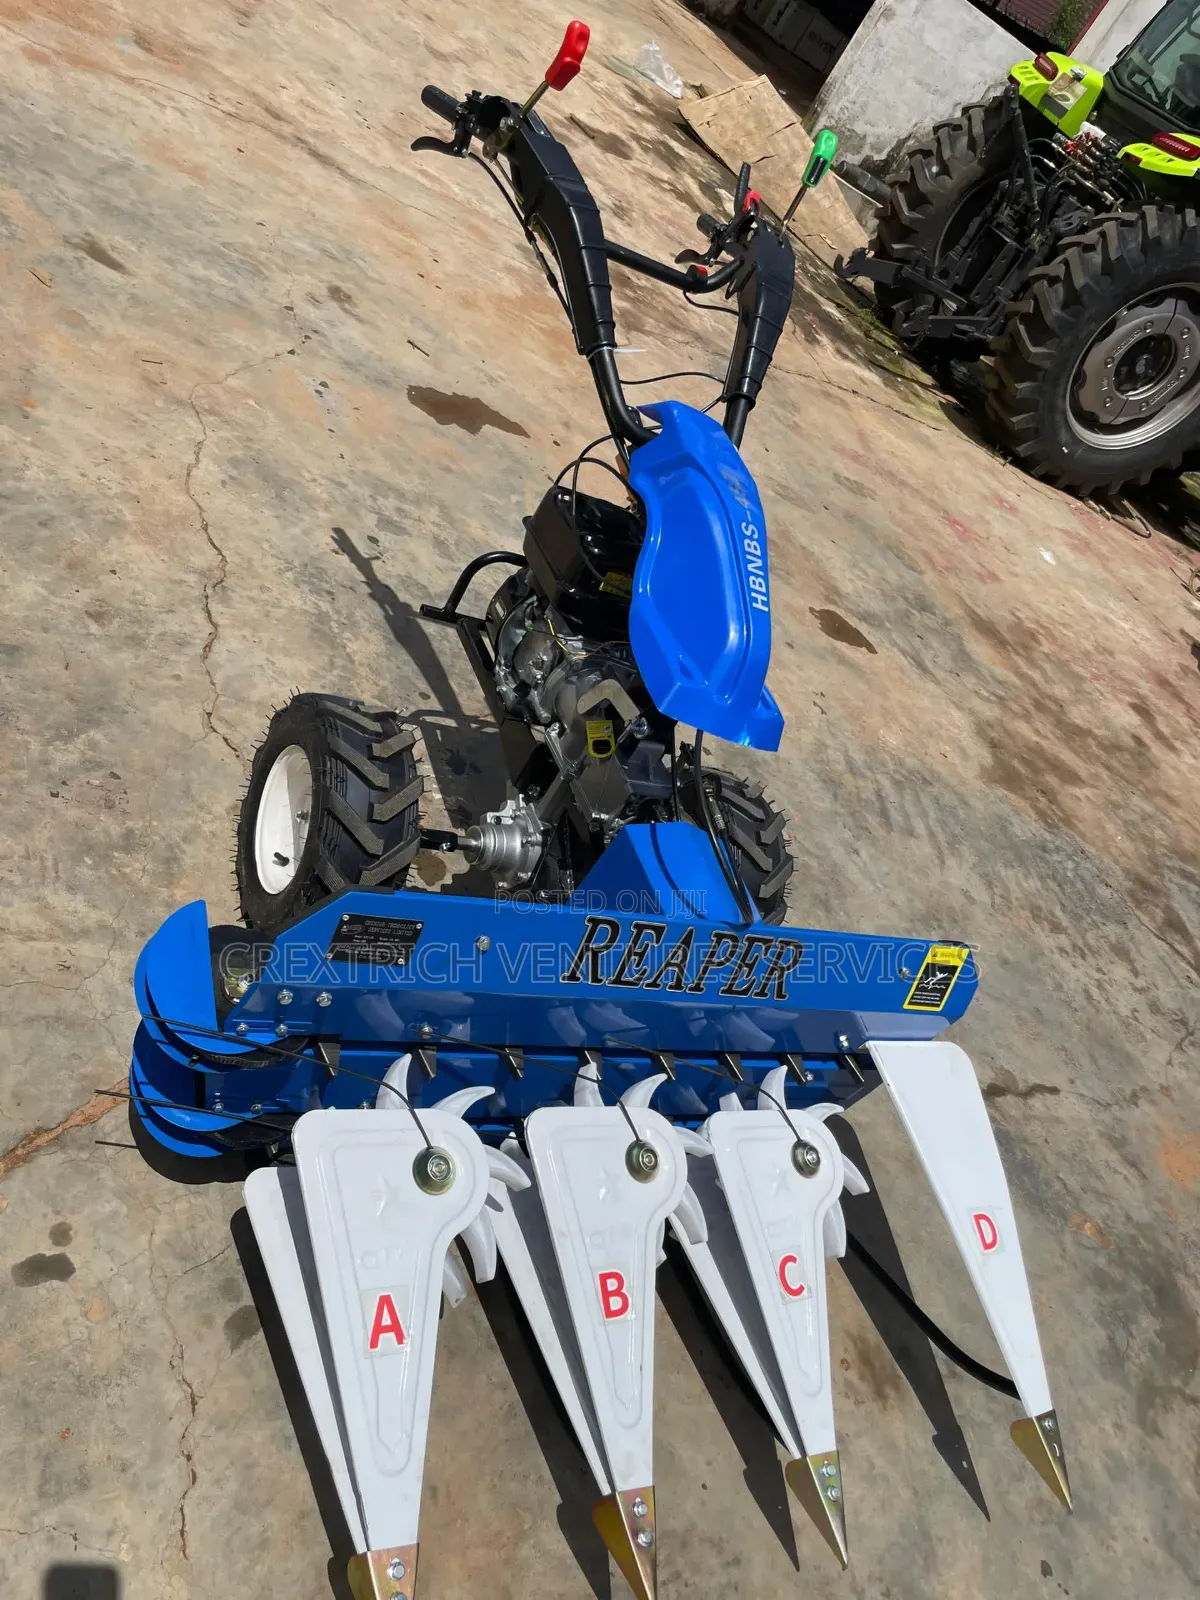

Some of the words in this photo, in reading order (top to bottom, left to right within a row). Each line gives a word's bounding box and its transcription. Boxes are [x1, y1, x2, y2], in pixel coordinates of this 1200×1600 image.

[560, 916, 804, 1001] REAPER
[974, 1214, 998, 1251] D
[599, 1271, 630, 1318] B
[779, 1255, 805, 1296] C
[369, 1294, 406, 1349] A
